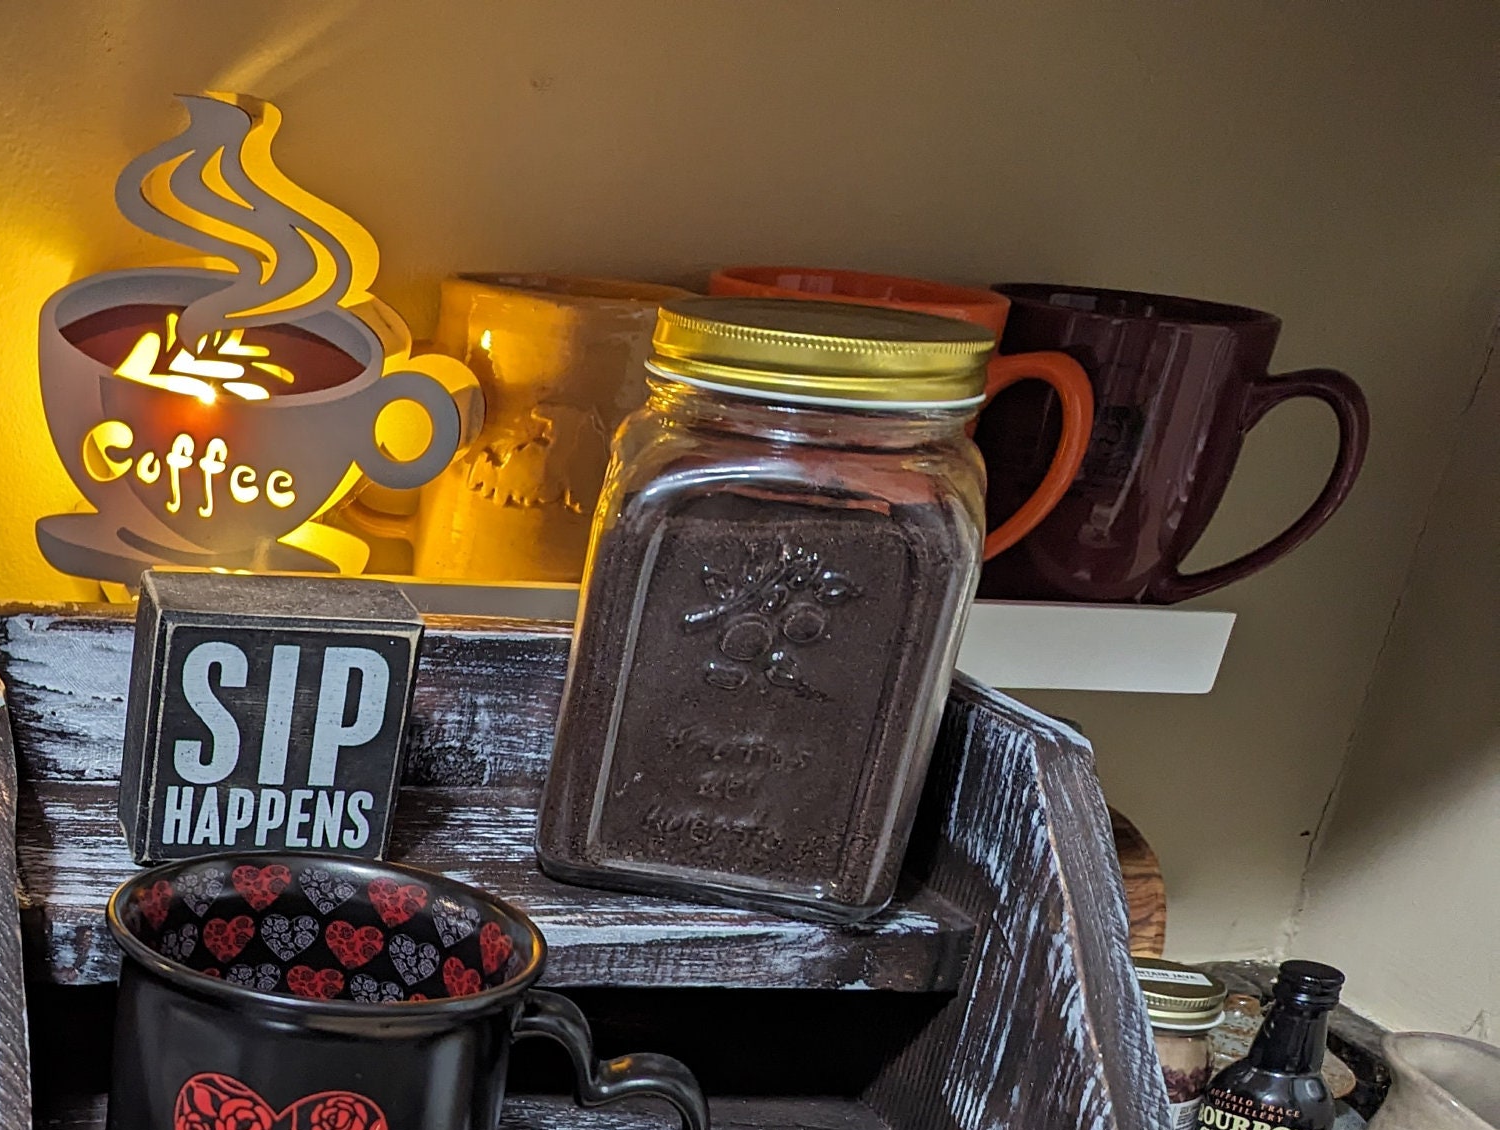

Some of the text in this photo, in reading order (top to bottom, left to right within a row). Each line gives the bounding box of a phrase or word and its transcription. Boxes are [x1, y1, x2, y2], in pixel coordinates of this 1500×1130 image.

[83, 420, 296, 518] Coffee
[173, 641, 390, 787] SIP
[162, 785, 374, 849] HAPPENS
[1215, 1098, 1284, 1123] DISTILLERY
[1260, 1103, 1301, 1118] TRACE
